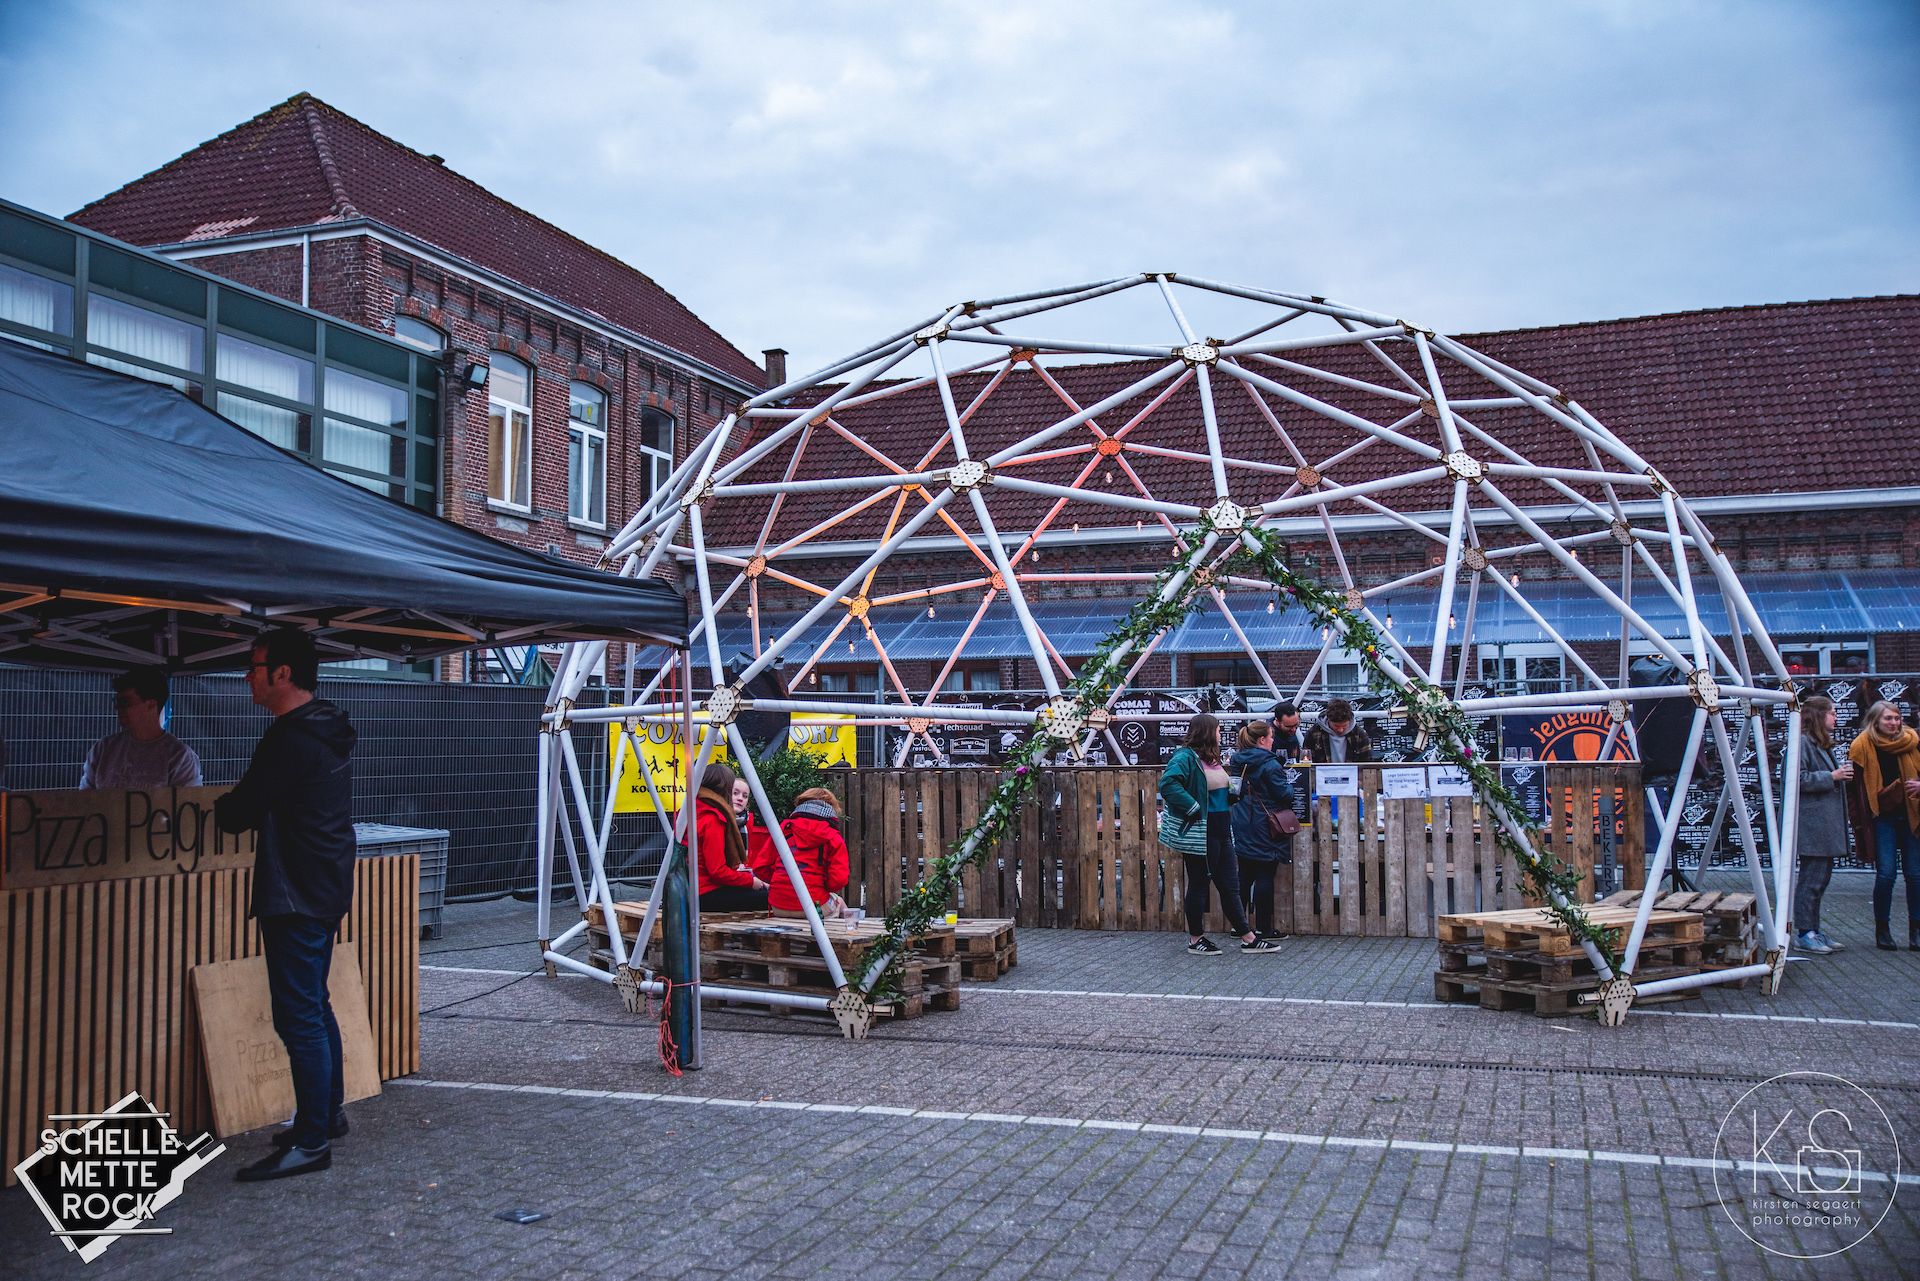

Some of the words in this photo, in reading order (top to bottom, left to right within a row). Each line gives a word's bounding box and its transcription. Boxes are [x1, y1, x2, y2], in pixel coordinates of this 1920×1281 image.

[1113, 700, 1151, 709] COMAR
[943, 723, 983, 732] Techsquad
[6, 794, 107, 873] Pizza
[1602, 815, 1613, 893] BEKERS
[236, 1039, 278, 1067] Pizza
